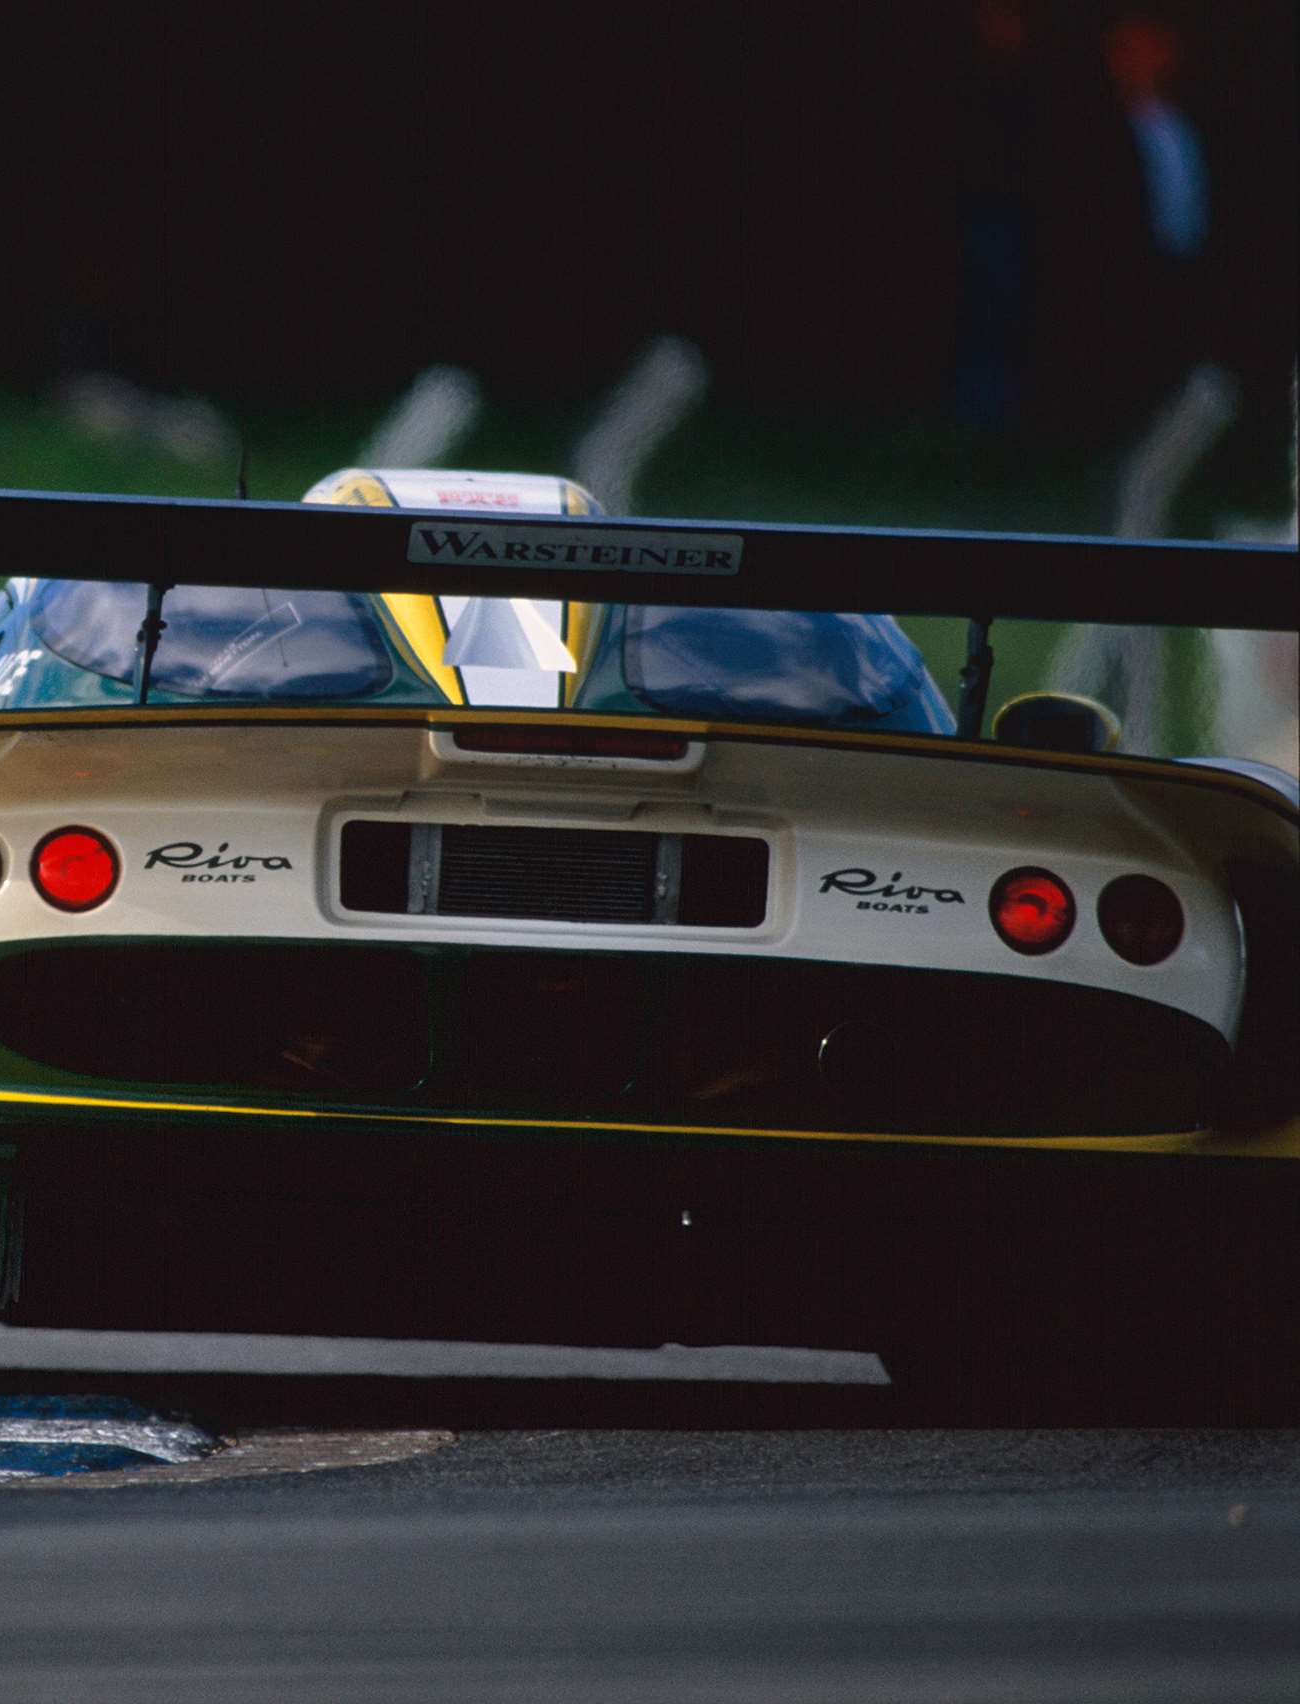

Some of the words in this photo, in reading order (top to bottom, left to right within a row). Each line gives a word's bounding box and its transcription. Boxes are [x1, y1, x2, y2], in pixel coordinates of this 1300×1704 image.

[418, 528, 734, 570] WARSTEINER
[144, 842, 292, 870] Riva
[181, 874, 257, 883] BOATS
[819, 868, 965, 904] Riva
[856, 901, 930, 914] BOATS
